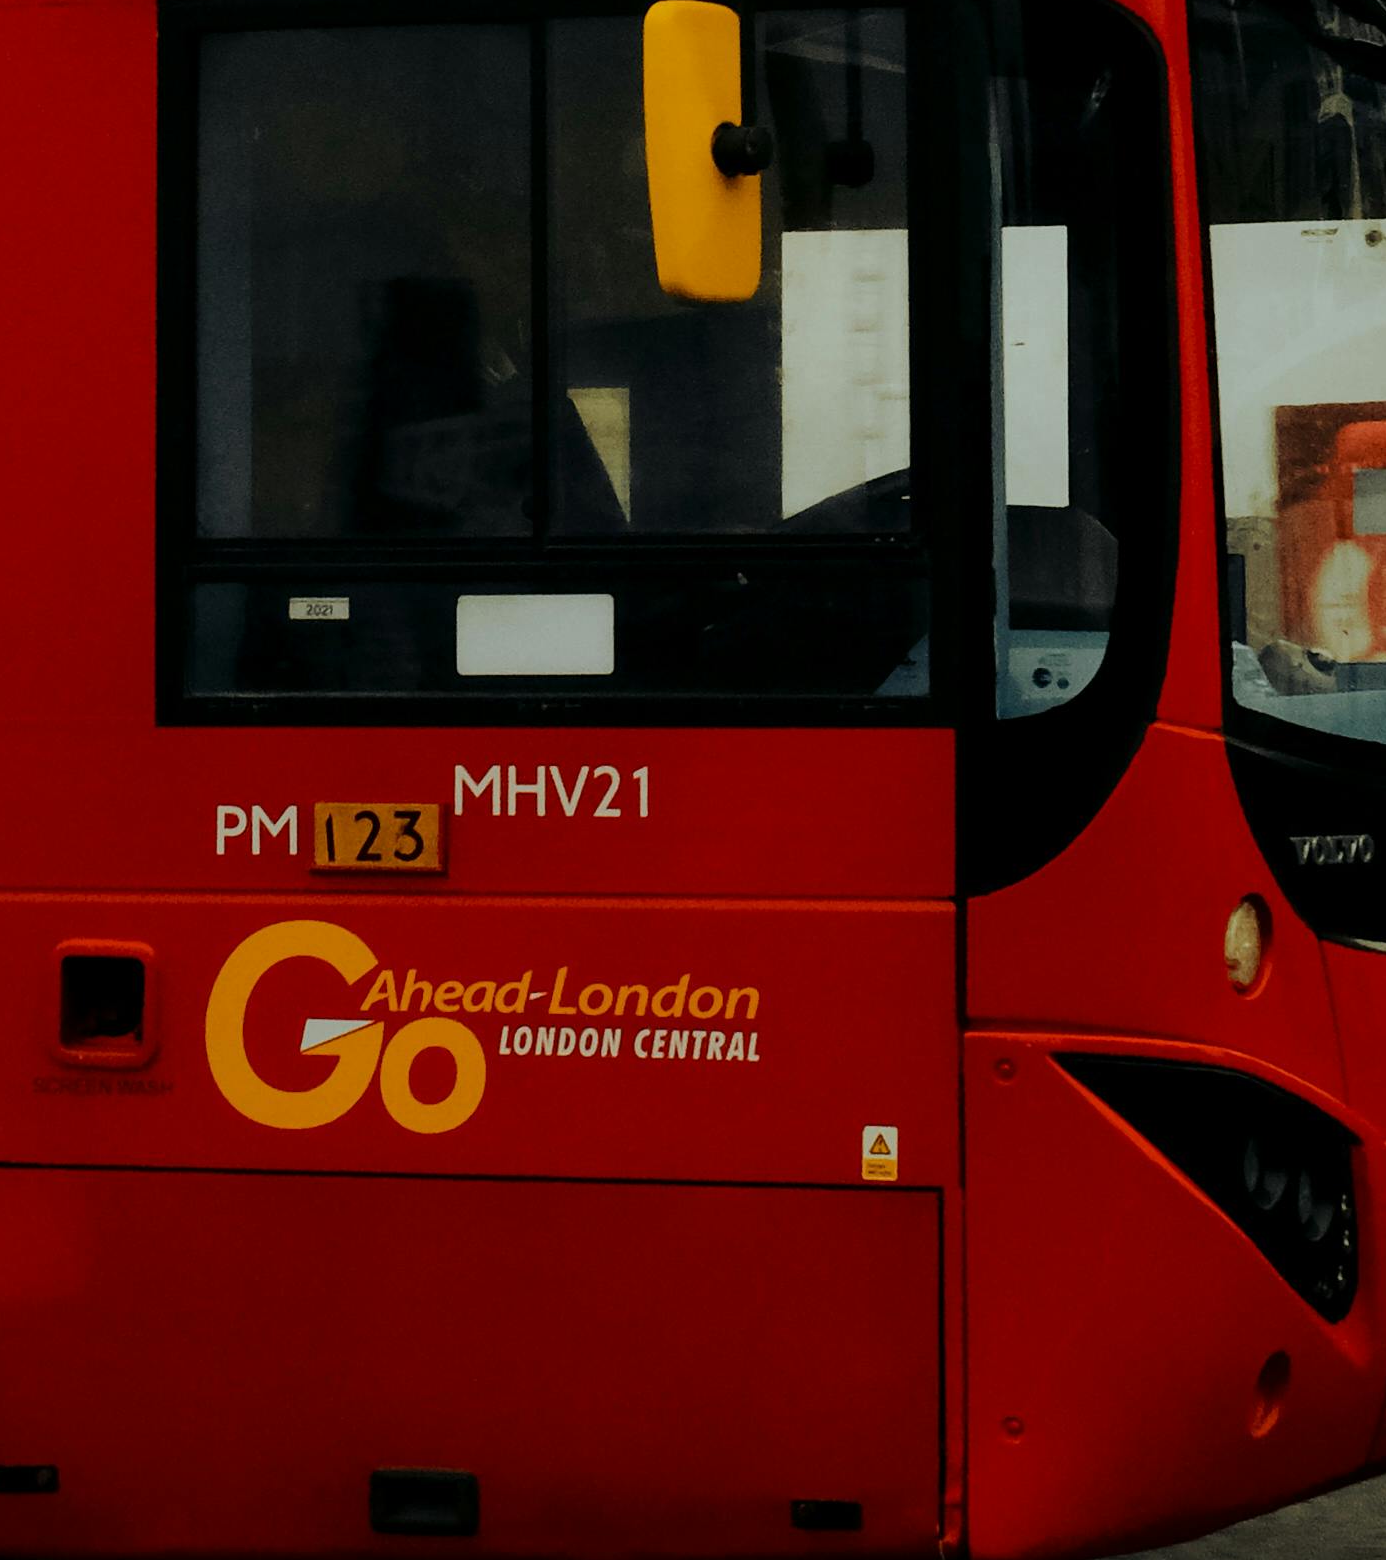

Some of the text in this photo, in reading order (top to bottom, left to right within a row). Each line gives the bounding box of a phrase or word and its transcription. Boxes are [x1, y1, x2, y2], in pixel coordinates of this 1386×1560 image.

[453, 765, 650, 818] MHV21
[216, 805, 298, 855] PM
[1290, 834, 1374, 864] VOLVO
[205, 920, 486, 1133] Go
[499, 1025, 760, 1063] LONDON CENTRAL
